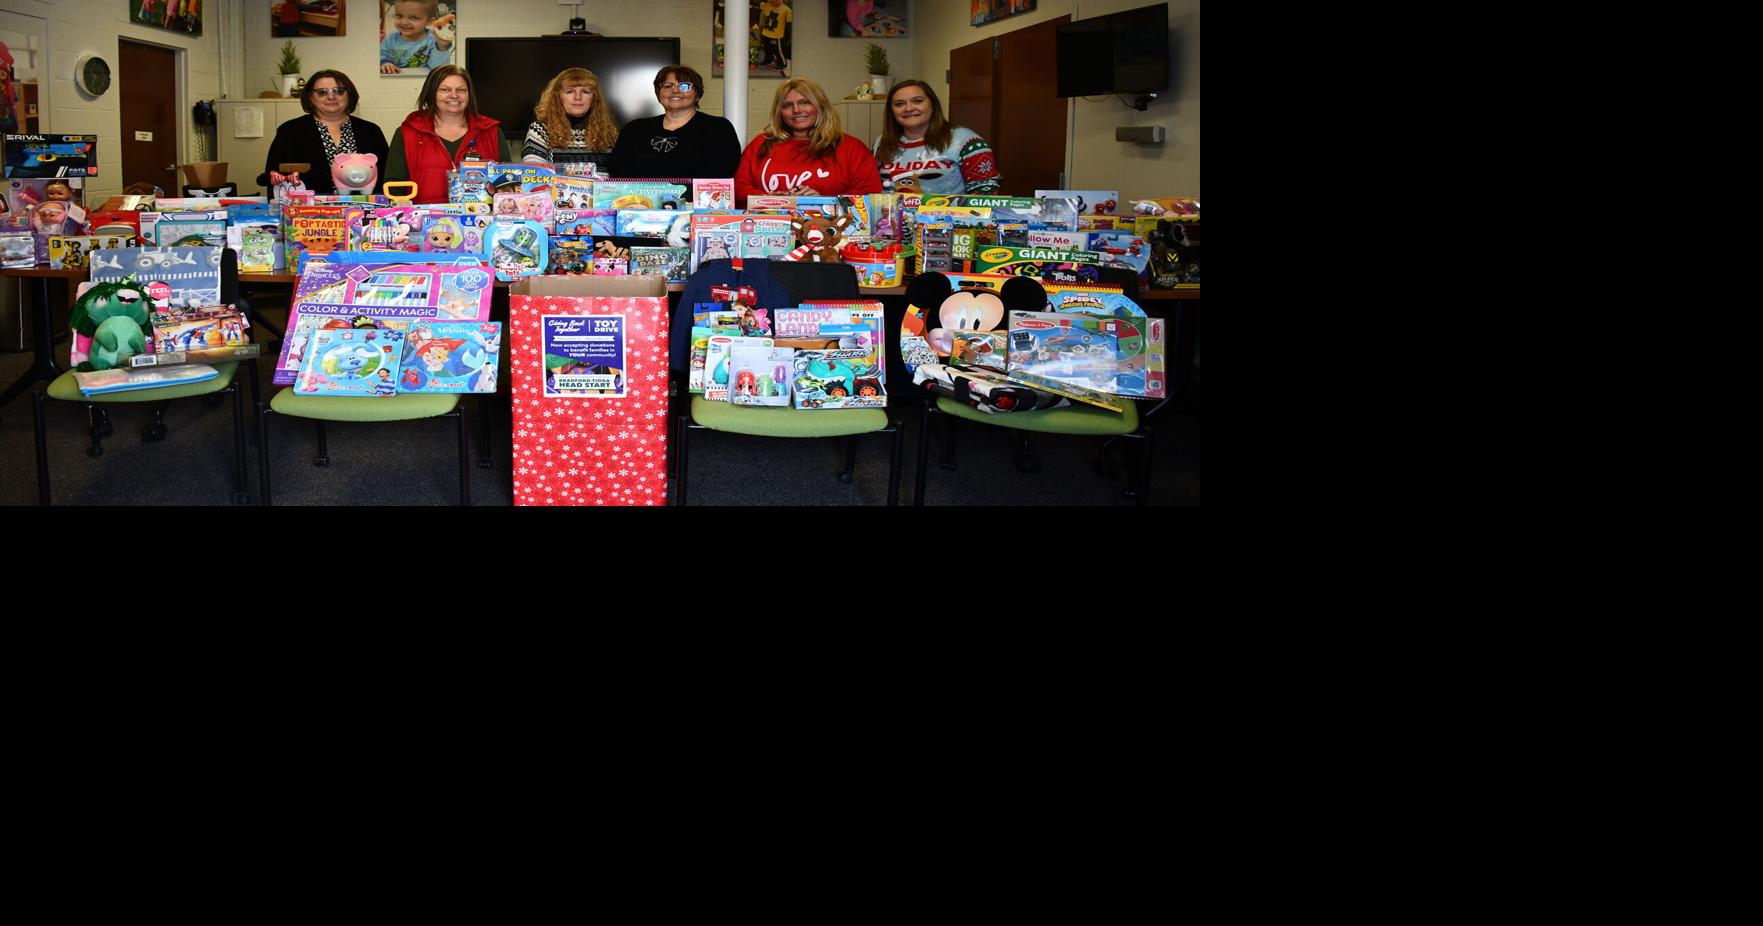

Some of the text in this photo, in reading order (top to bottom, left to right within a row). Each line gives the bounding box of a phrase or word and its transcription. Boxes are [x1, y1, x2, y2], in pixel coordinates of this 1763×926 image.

[881, 160, 956, 170] OLIDAY
[761, 158, 812, 192] love
[969, 198, 1009, 207] GIANT
[302, 228, 337, 237] JUNGLE
[953, 235, 971, 245] IG
[637, 253, 668, 261] DINO
[1019, 249, 1070, 260] GIANT
[462, 274, 482, 283] 100
[1063, 296, 1104, 304] SPIDEY
[299, 305, 338, 314] COLOR
[349, 307, 398, 315] ACTIVITY
[399, 308, 436, 316] MAGIC
[776, 310, 833, 323] CANDY
[776, 323, 818, 335] LAND
